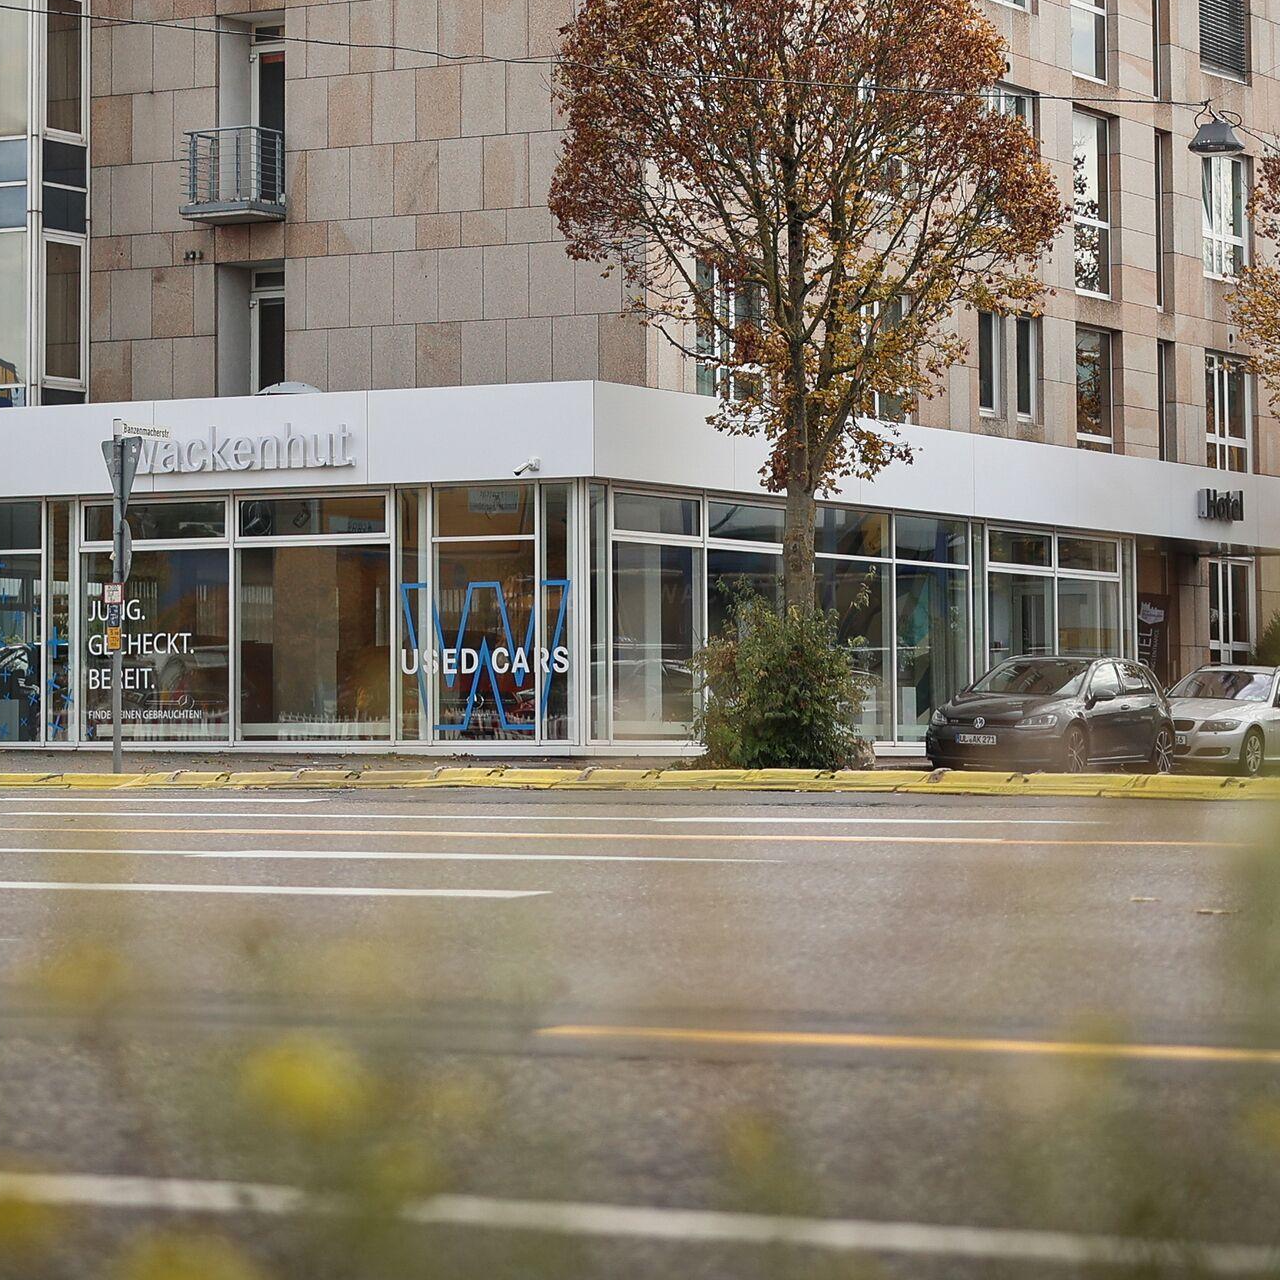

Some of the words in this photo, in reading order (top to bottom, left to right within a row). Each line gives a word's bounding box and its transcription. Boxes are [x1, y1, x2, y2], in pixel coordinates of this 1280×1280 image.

[1198, 488, 1244, 522] Hotel
[401, 648, 480, 675] USED
[491, 646, 570, 674] CARS
[88, 710, 111, 720] FINDE
[143, 709, 202, 720] GEBRAUCHTEN!
